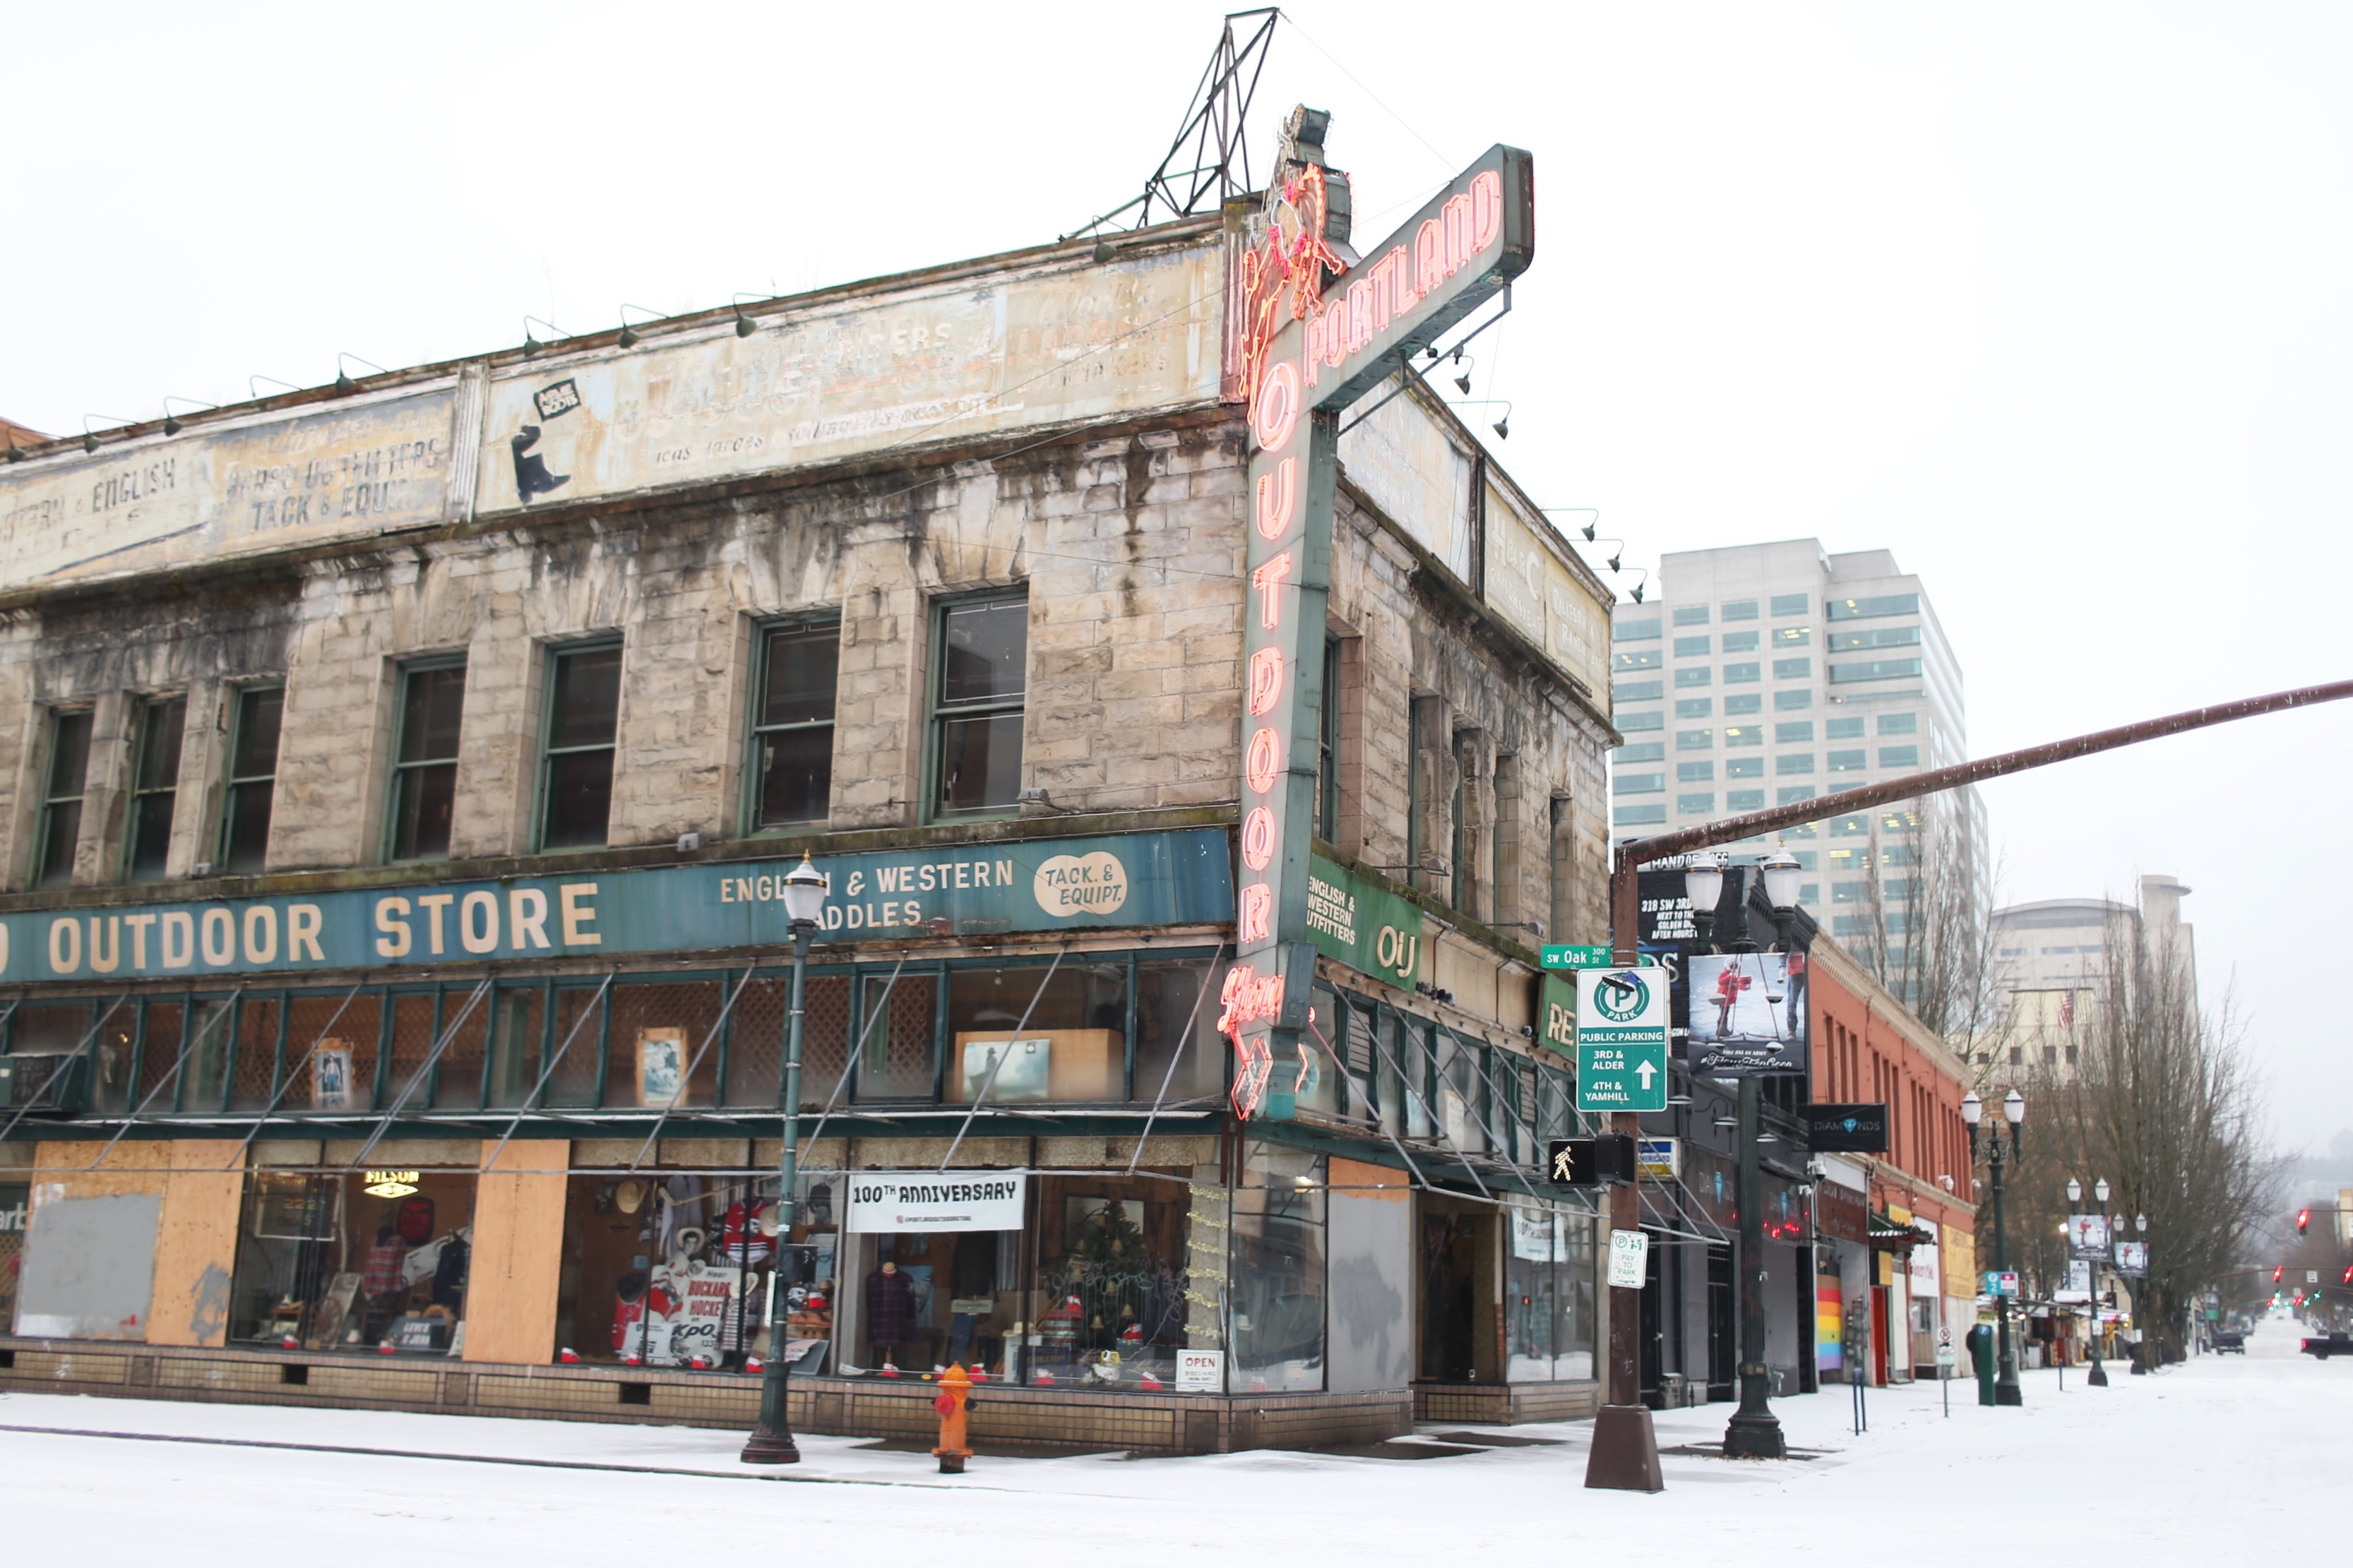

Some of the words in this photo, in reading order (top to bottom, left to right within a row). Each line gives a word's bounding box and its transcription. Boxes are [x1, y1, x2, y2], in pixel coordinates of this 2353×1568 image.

[1304, 170, 1501, 387] PORTLAND
[93, 457, 176, 513] ENGLISH
[252, 493, 312, 531] TACK
[1240, 361, 1299, 944] OUTDOOR
[1652, 854, 1685, 869] HAND
[1103, 864, 1114, 881] &
[721, 872, 830, 903] ENGLH
[847, 870, 866, 896] &
[876, 859, 1013, 893] WESTERN
[1307, 896, 1352, 926] WESTERN
[1348, 896, 1356, 912] &
[1641, 899, 1659, 913] 318
[1660, 898, 1675, 911] SW
[375, 882, 602, 958] STORE
[813, 899, 922, 931] ADDLES
[1656, 911, 1674, 921] NEXT
[1674, 910, 1683, 920] TO
[1306, 909, 1356, 945] UTFITTERS
[1657, 920, 1683, 930] GOLDEN
[48, 904, 326, 974] OUTDOOR
[1651, 930, 1672, 940] AFTER
[1672, 928, 1695, 939] HOURS
[1376, 924, 1416, 978] OU
[1563, 950, 1587, 964] Oak
[1615, 988, 1631, 1008] P
[1607, 1010, 1638, 1021] PARK
[1580, 1032, 1616, 1042] PUBLIC
[1618, 1031, 1664, 1041] PARKING
[1593, 1051, 1614, 1060] 3RD
[1615, 1050, 1624, 1060] &
[1592, 1061, 1624, 1070] ALDER
[1592, 1082, 1612, 1091] 4TH
[1614, 1082, 1623, 1091] &
[1585, 1091, 1630, 1101] YAMHILL
[1813, 1120, 1881, 1132] DIAMNDS
[899, 1181, 1016, 1203] ANNIVERSARY
[688, 1280, 732, 1298] BUCKARO
[1990, 1283, 1998, 1293] 2
[689, 1300, 722, 1317] HOCKE
[1185, 1356, 1216, 1368] OPEN
